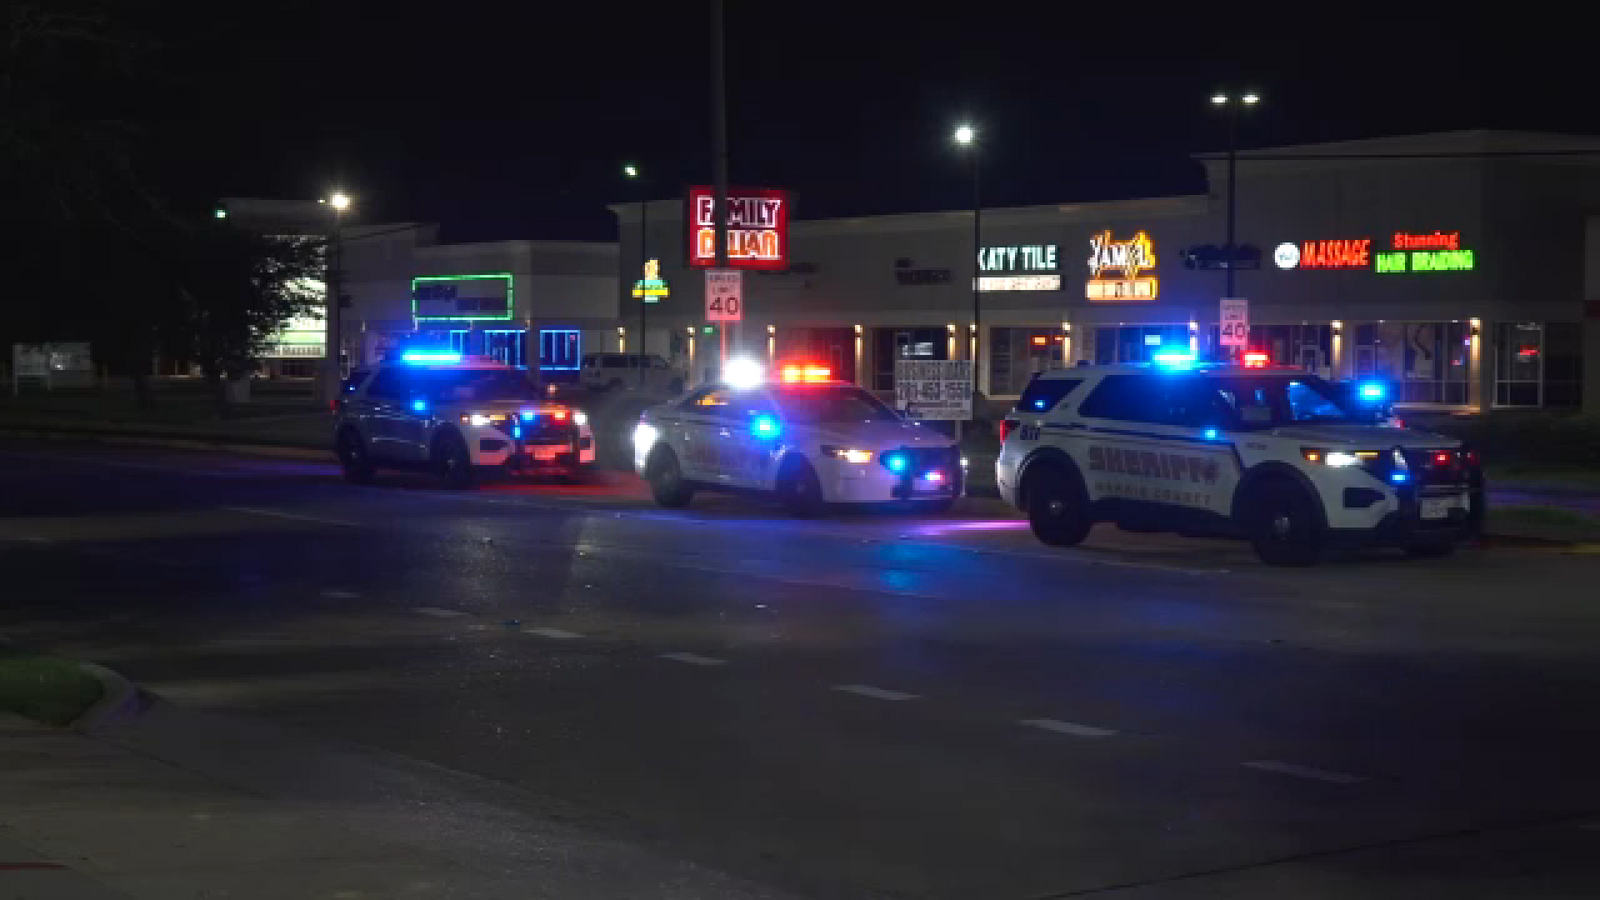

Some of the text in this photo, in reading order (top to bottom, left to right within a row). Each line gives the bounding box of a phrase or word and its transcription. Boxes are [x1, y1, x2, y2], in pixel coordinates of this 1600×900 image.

[697, 194, 782, 228] FMILY
[696, 228, 782, 260] DLLAR
[1393, 231, 1459, 250] Stunning
[1022, 245, 1057, 269] TILE
[1301, 240, 1370, 268] MASSAGE
[1376, 250, 1474, 273] HAIR BRAIDING
[709, 297, 739, 315] 40
[1222, 322, 1247, 340] 40
[1089, 446, 1203, 482] SHERIFF
